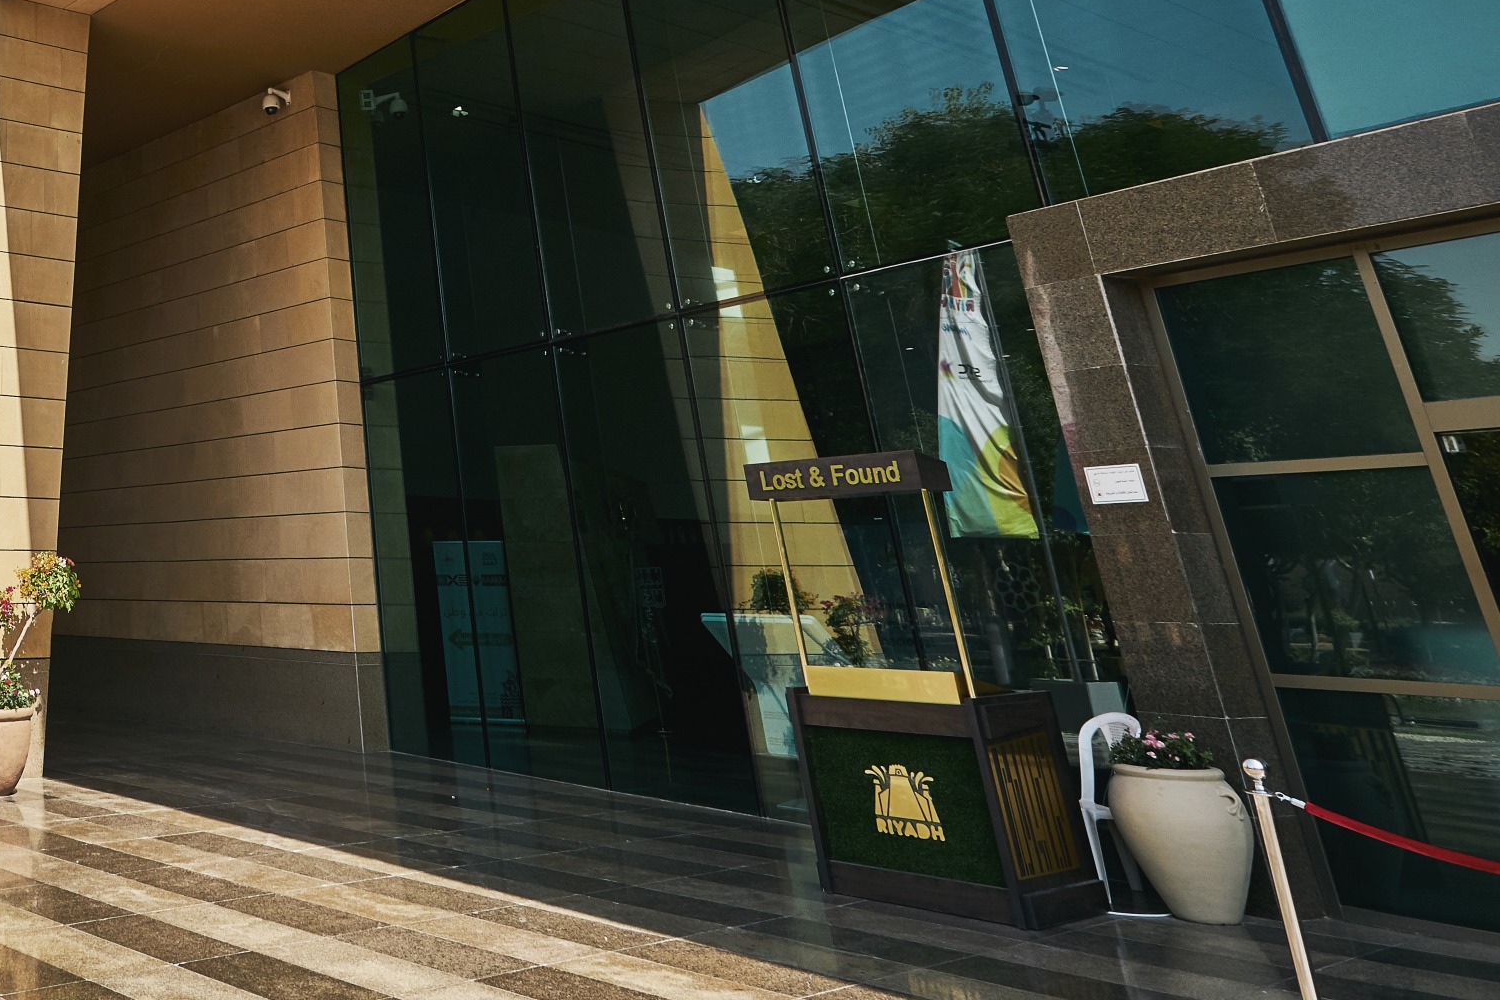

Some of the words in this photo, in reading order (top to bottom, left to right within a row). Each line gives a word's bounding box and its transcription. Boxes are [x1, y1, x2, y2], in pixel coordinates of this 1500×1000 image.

[759, 468, 805, 491] Lost
[809, 466, 826, 488] &
[830, 460, 901, 487] Found
[875, 817, 946, 842] RIYADH
